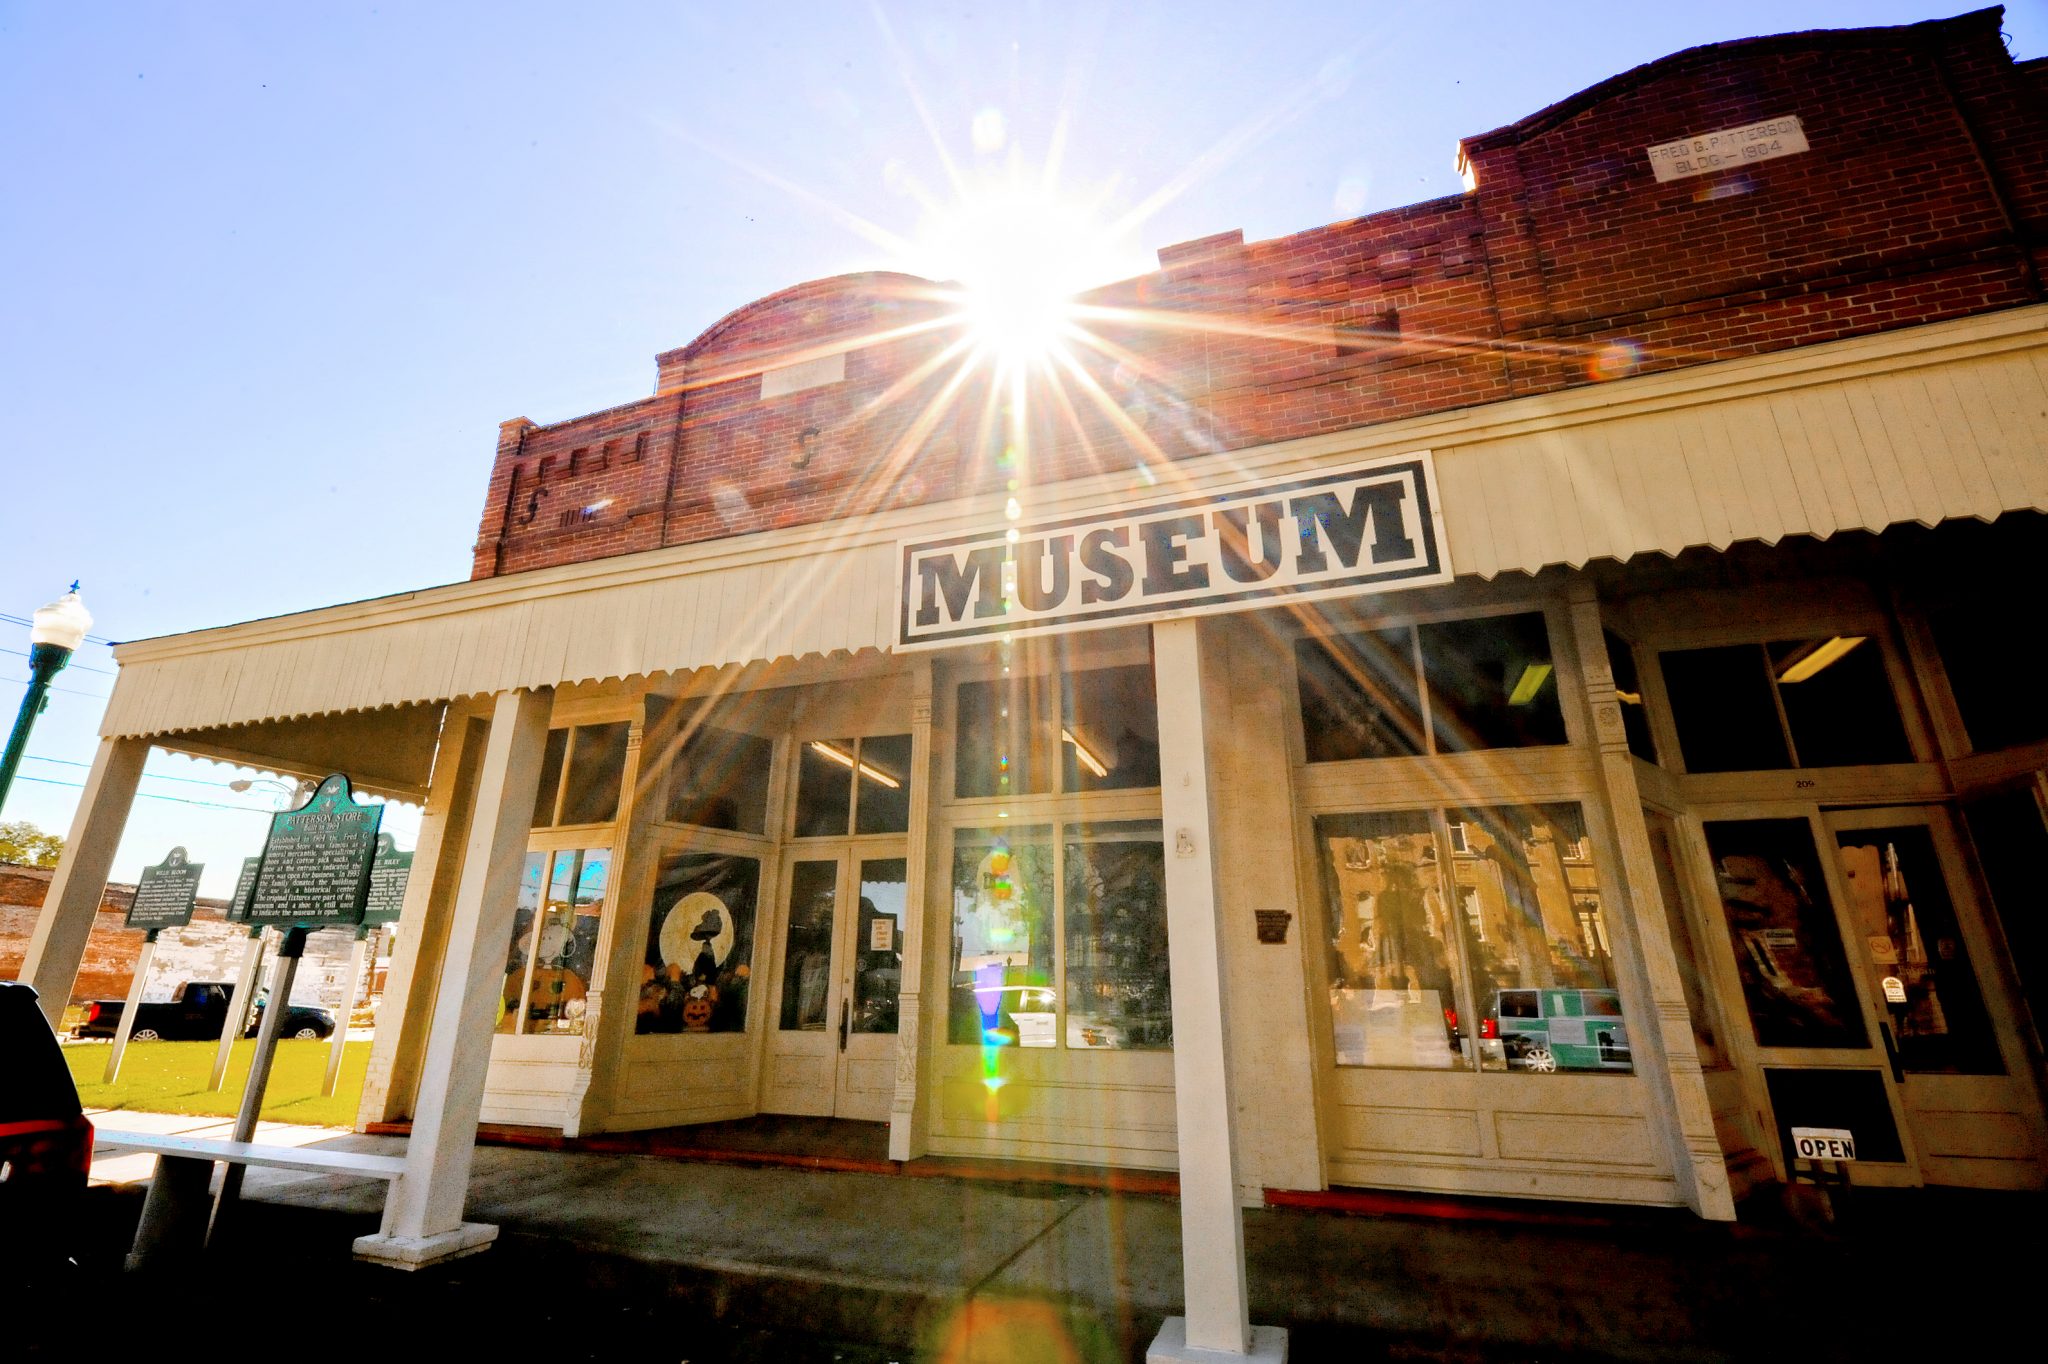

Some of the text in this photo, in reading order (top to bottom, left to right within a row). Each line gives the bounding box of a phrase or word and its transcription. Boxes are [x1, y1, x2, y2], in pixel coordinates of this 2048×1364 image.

[1711, 119, 1799, 147] PTTERSON
[915, 480, 1416, 625] MUSEUM
[287, 811, 363, 825] PATTERSON STORE
[344, 832, 358, 840] Fred
[322, 863, 349, 871] indicated
[287, 873, 301, 881] open
[271, 880, 288, 888] family
[331, 878, 359, 886] buildings
[256, 894, 266, 902] The
[266, 894, 288, 902] original
[322, 894, 336, 902] part
[277, 901, 289, 909] and
[339, 901, 354, 909] used
[258, 908, 281, 916] indicate
[1800, 1139, 1854, 1158] OPEN
